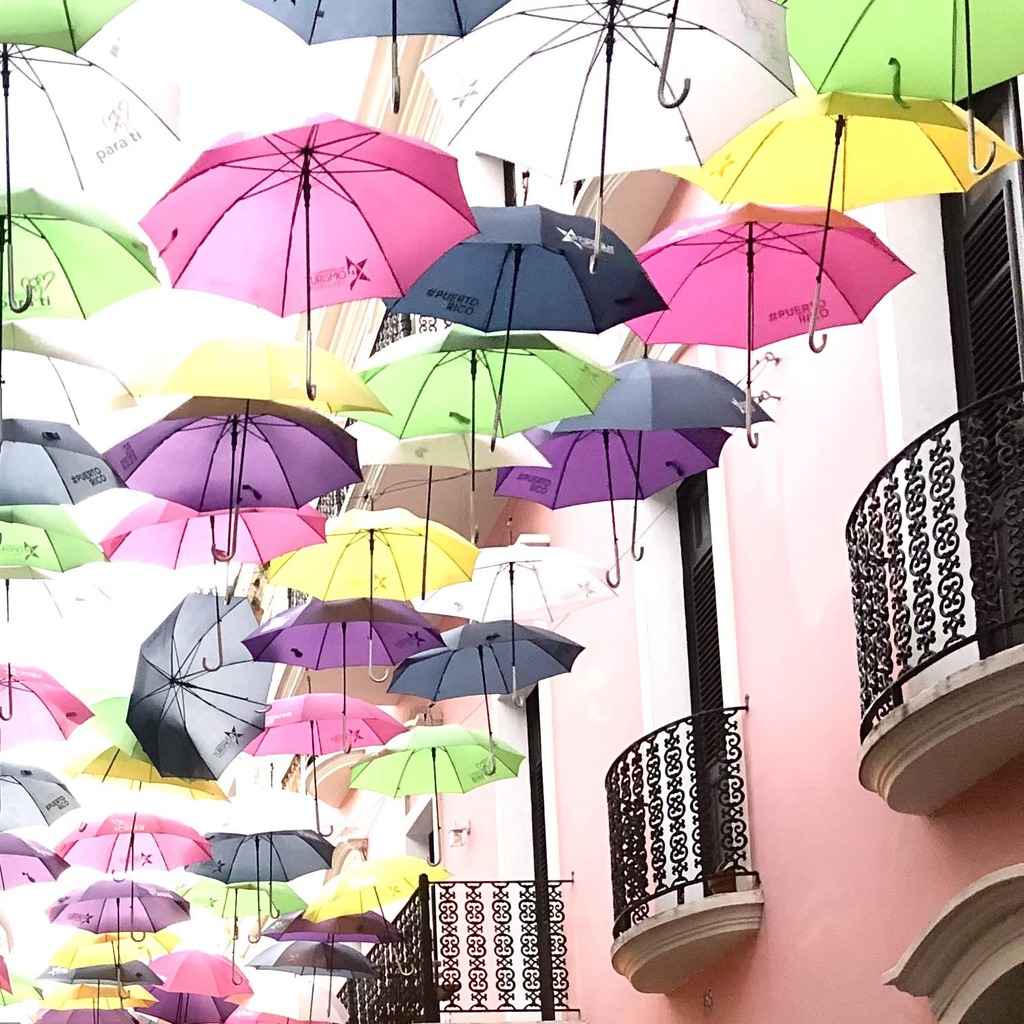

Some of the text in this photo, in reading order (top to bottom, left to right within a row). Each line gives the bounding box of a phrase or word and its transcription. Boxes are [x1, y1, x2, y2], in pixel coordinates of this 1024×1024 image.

[95, 128, 142, 164] para ti
[426, 287, 480, 308] #PUERTO
[445, 300, 475, 317] RICO
[71, 467, 102, 484] #PUERTO
[88, 474, 108, 487] RICO
